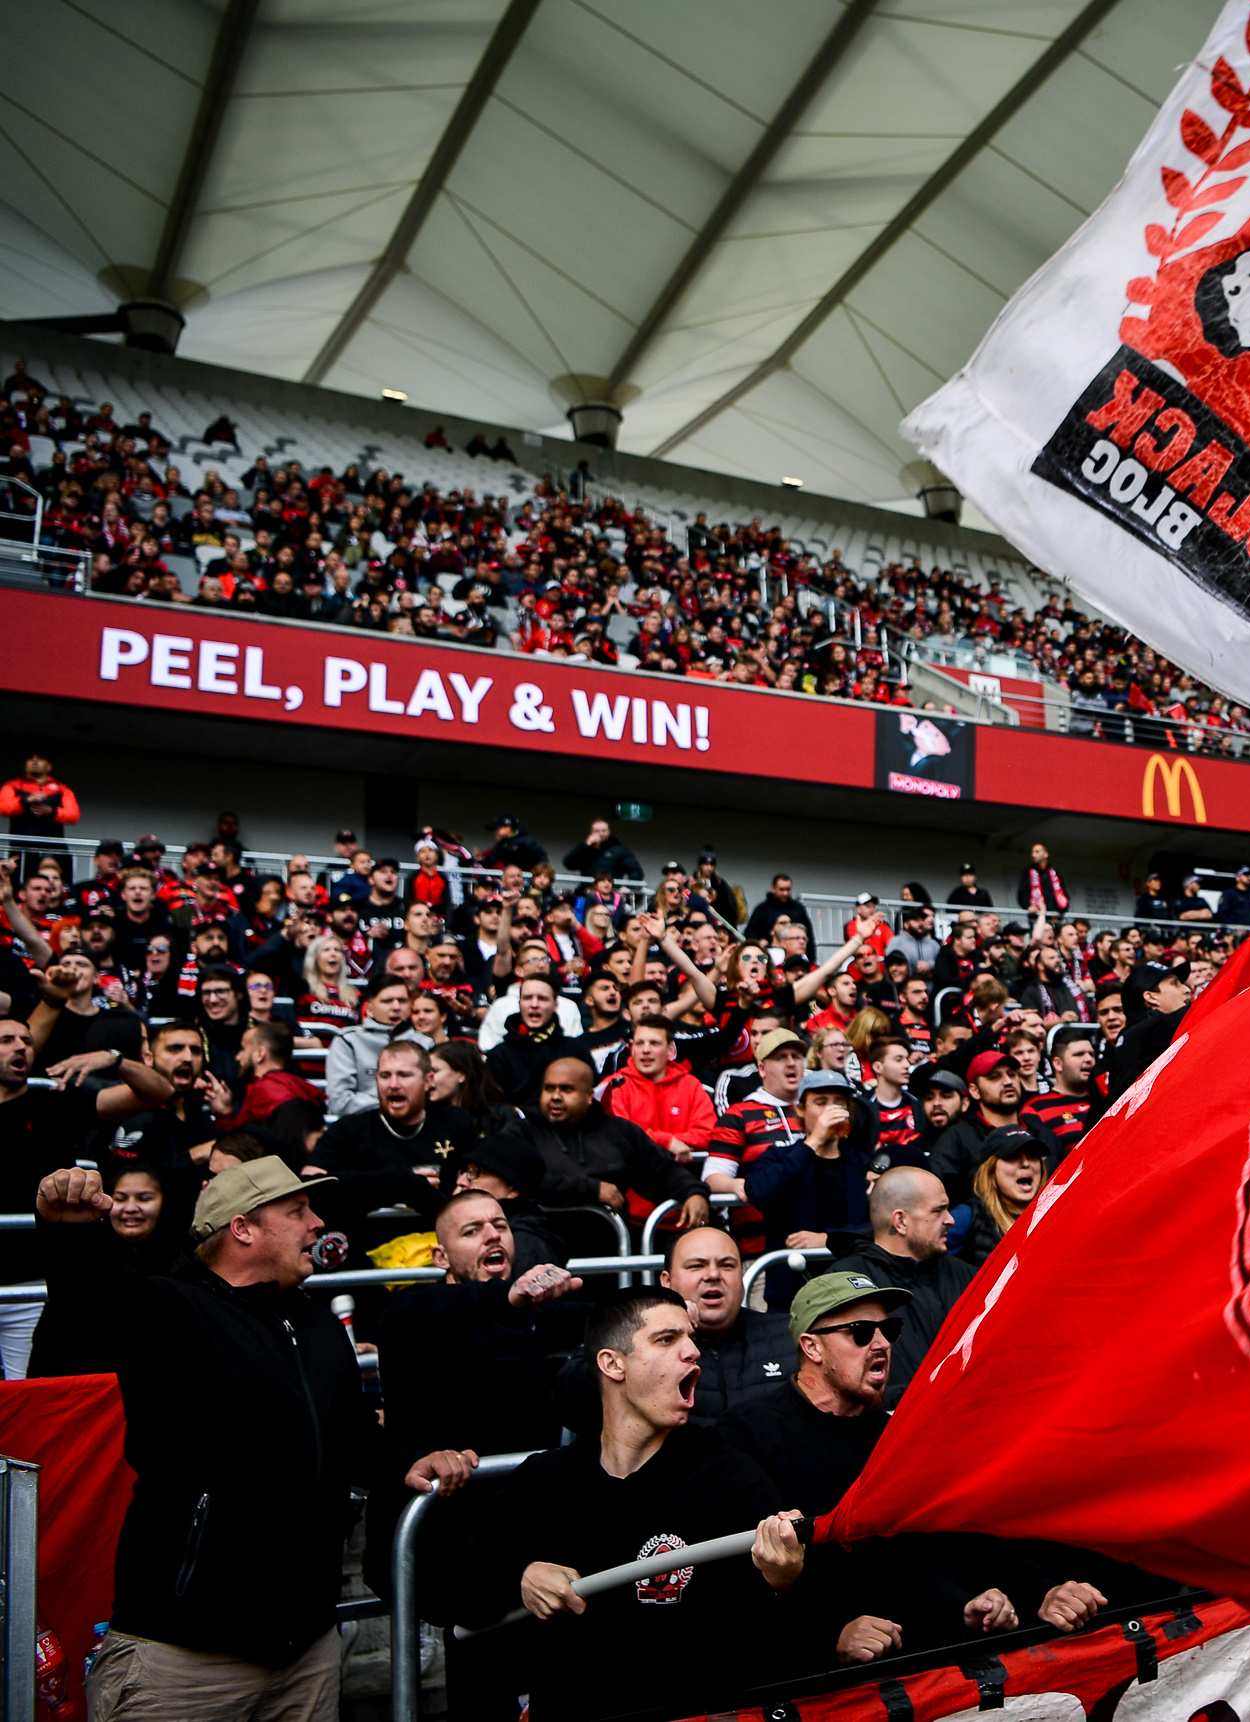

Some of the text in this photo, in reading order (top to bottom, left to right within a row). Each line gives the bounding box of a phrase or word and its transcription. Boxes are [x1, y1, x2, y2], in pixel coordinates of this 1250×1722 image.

[100, 626, 711, 752] PEEL, PLAY & WIN!
[892, 776, 960, 799] MONOPOLY
